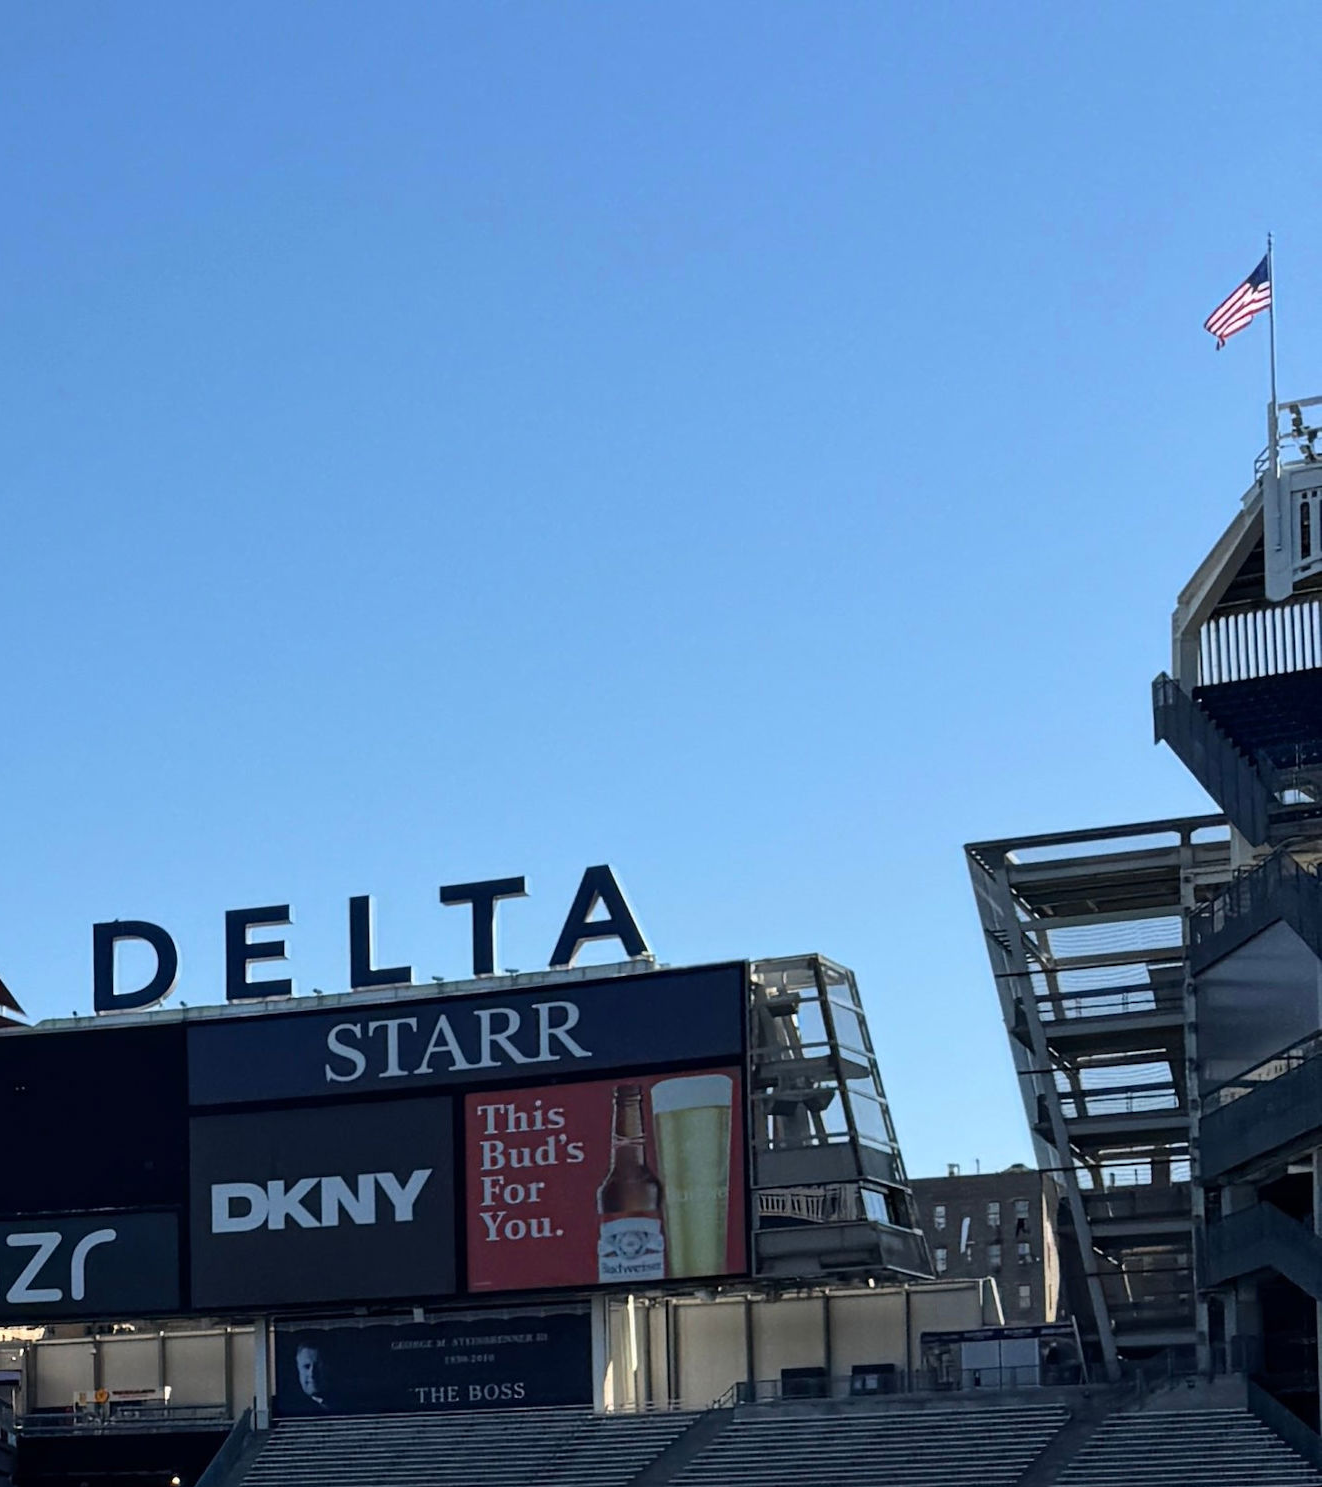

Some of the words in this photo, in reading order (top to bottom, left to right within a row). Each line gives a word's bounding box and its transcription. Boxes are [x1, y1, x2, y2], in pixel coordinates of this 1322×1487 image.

[92, 863, 652, 1015] DELTA
[324, 1000, 593, 1084] STARR
[477, 1100, 566, 1135] This
[479, 1134, 585, 1171] Bud's
[210, 1168, 433, 1234] DKNY
[479, 1175, 546, 1207] For
[479, 1211, 565, 1242] You.
[414, 1385, 460, 1403] THE
[468, 1382, 526, 1401] BOSS
